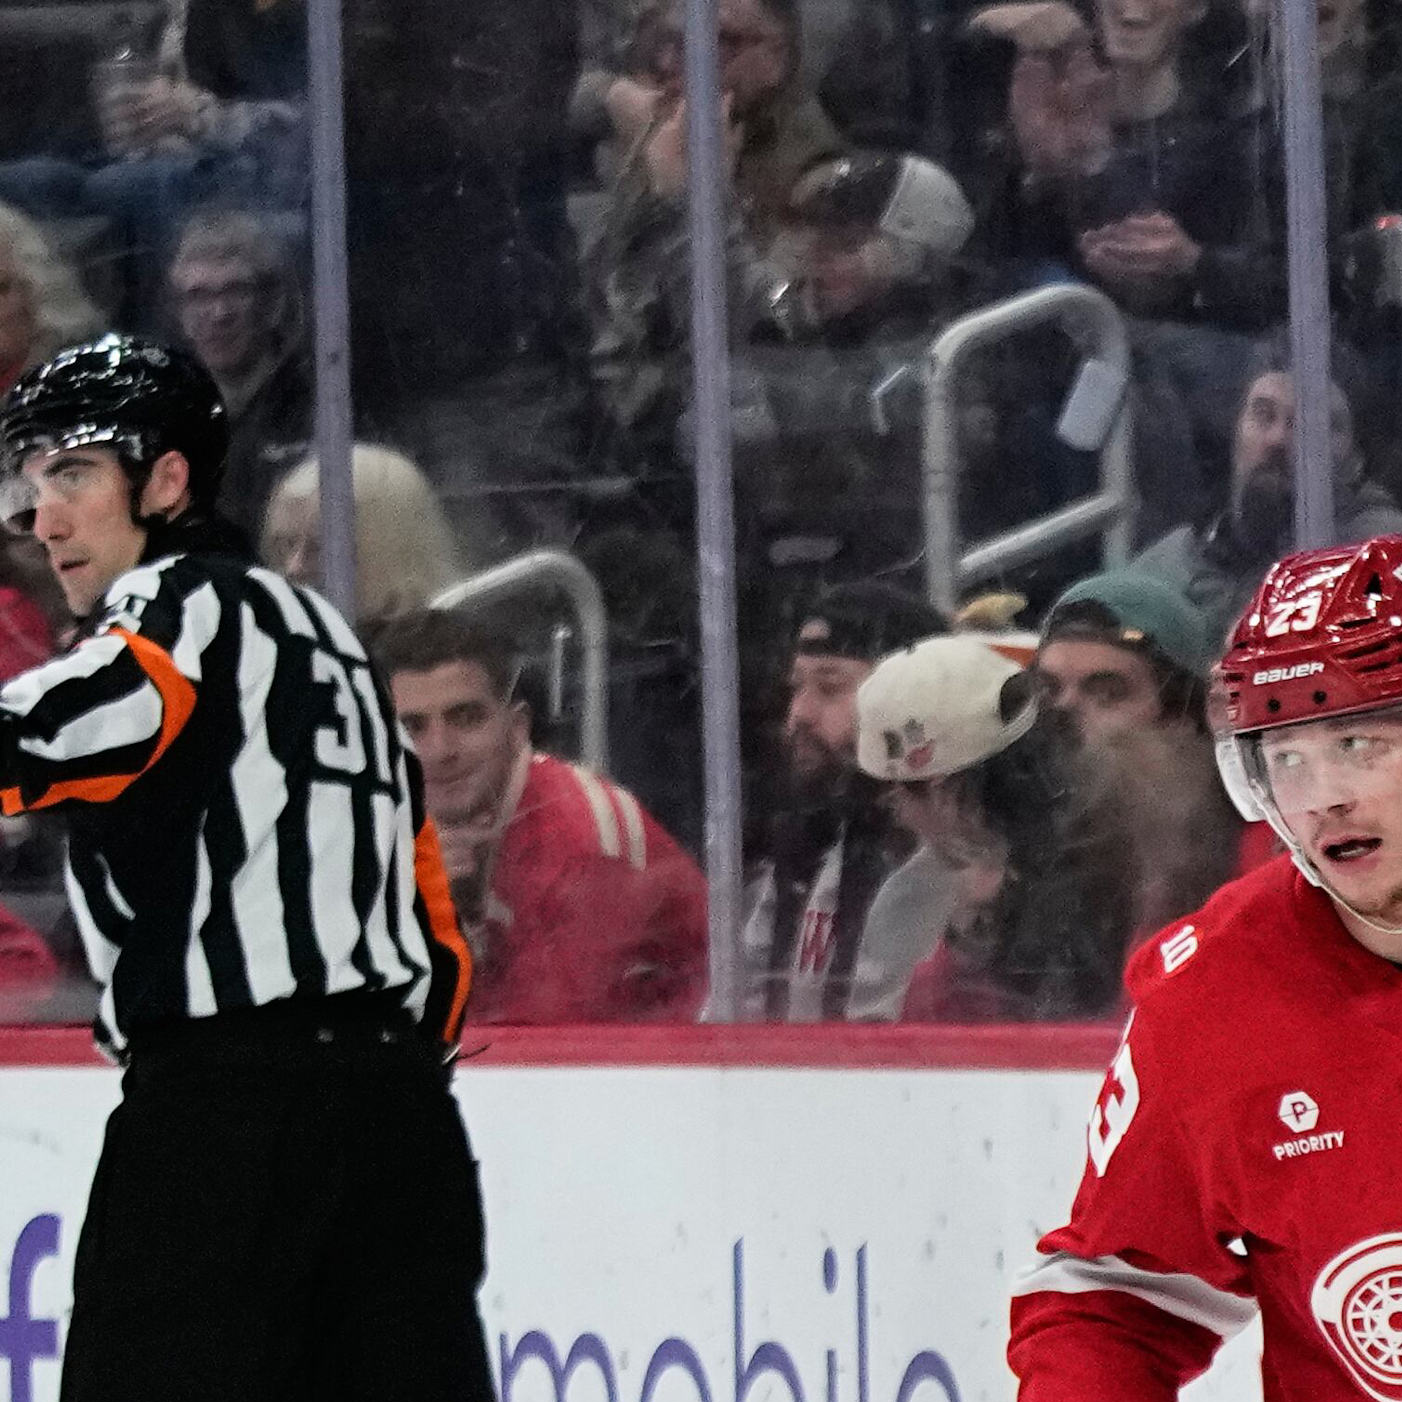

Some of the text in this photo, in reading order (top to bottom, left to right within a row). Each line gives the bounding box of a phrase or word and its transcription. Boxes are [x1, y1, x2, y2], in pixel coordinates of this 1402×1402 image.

[1264, 591, 1323, 638] 23
[1253, 662, 1325, 686] BAUER
[311, 648, 392, 784] 31
[1272, 1131, 1345, 1161] PRIORITY
